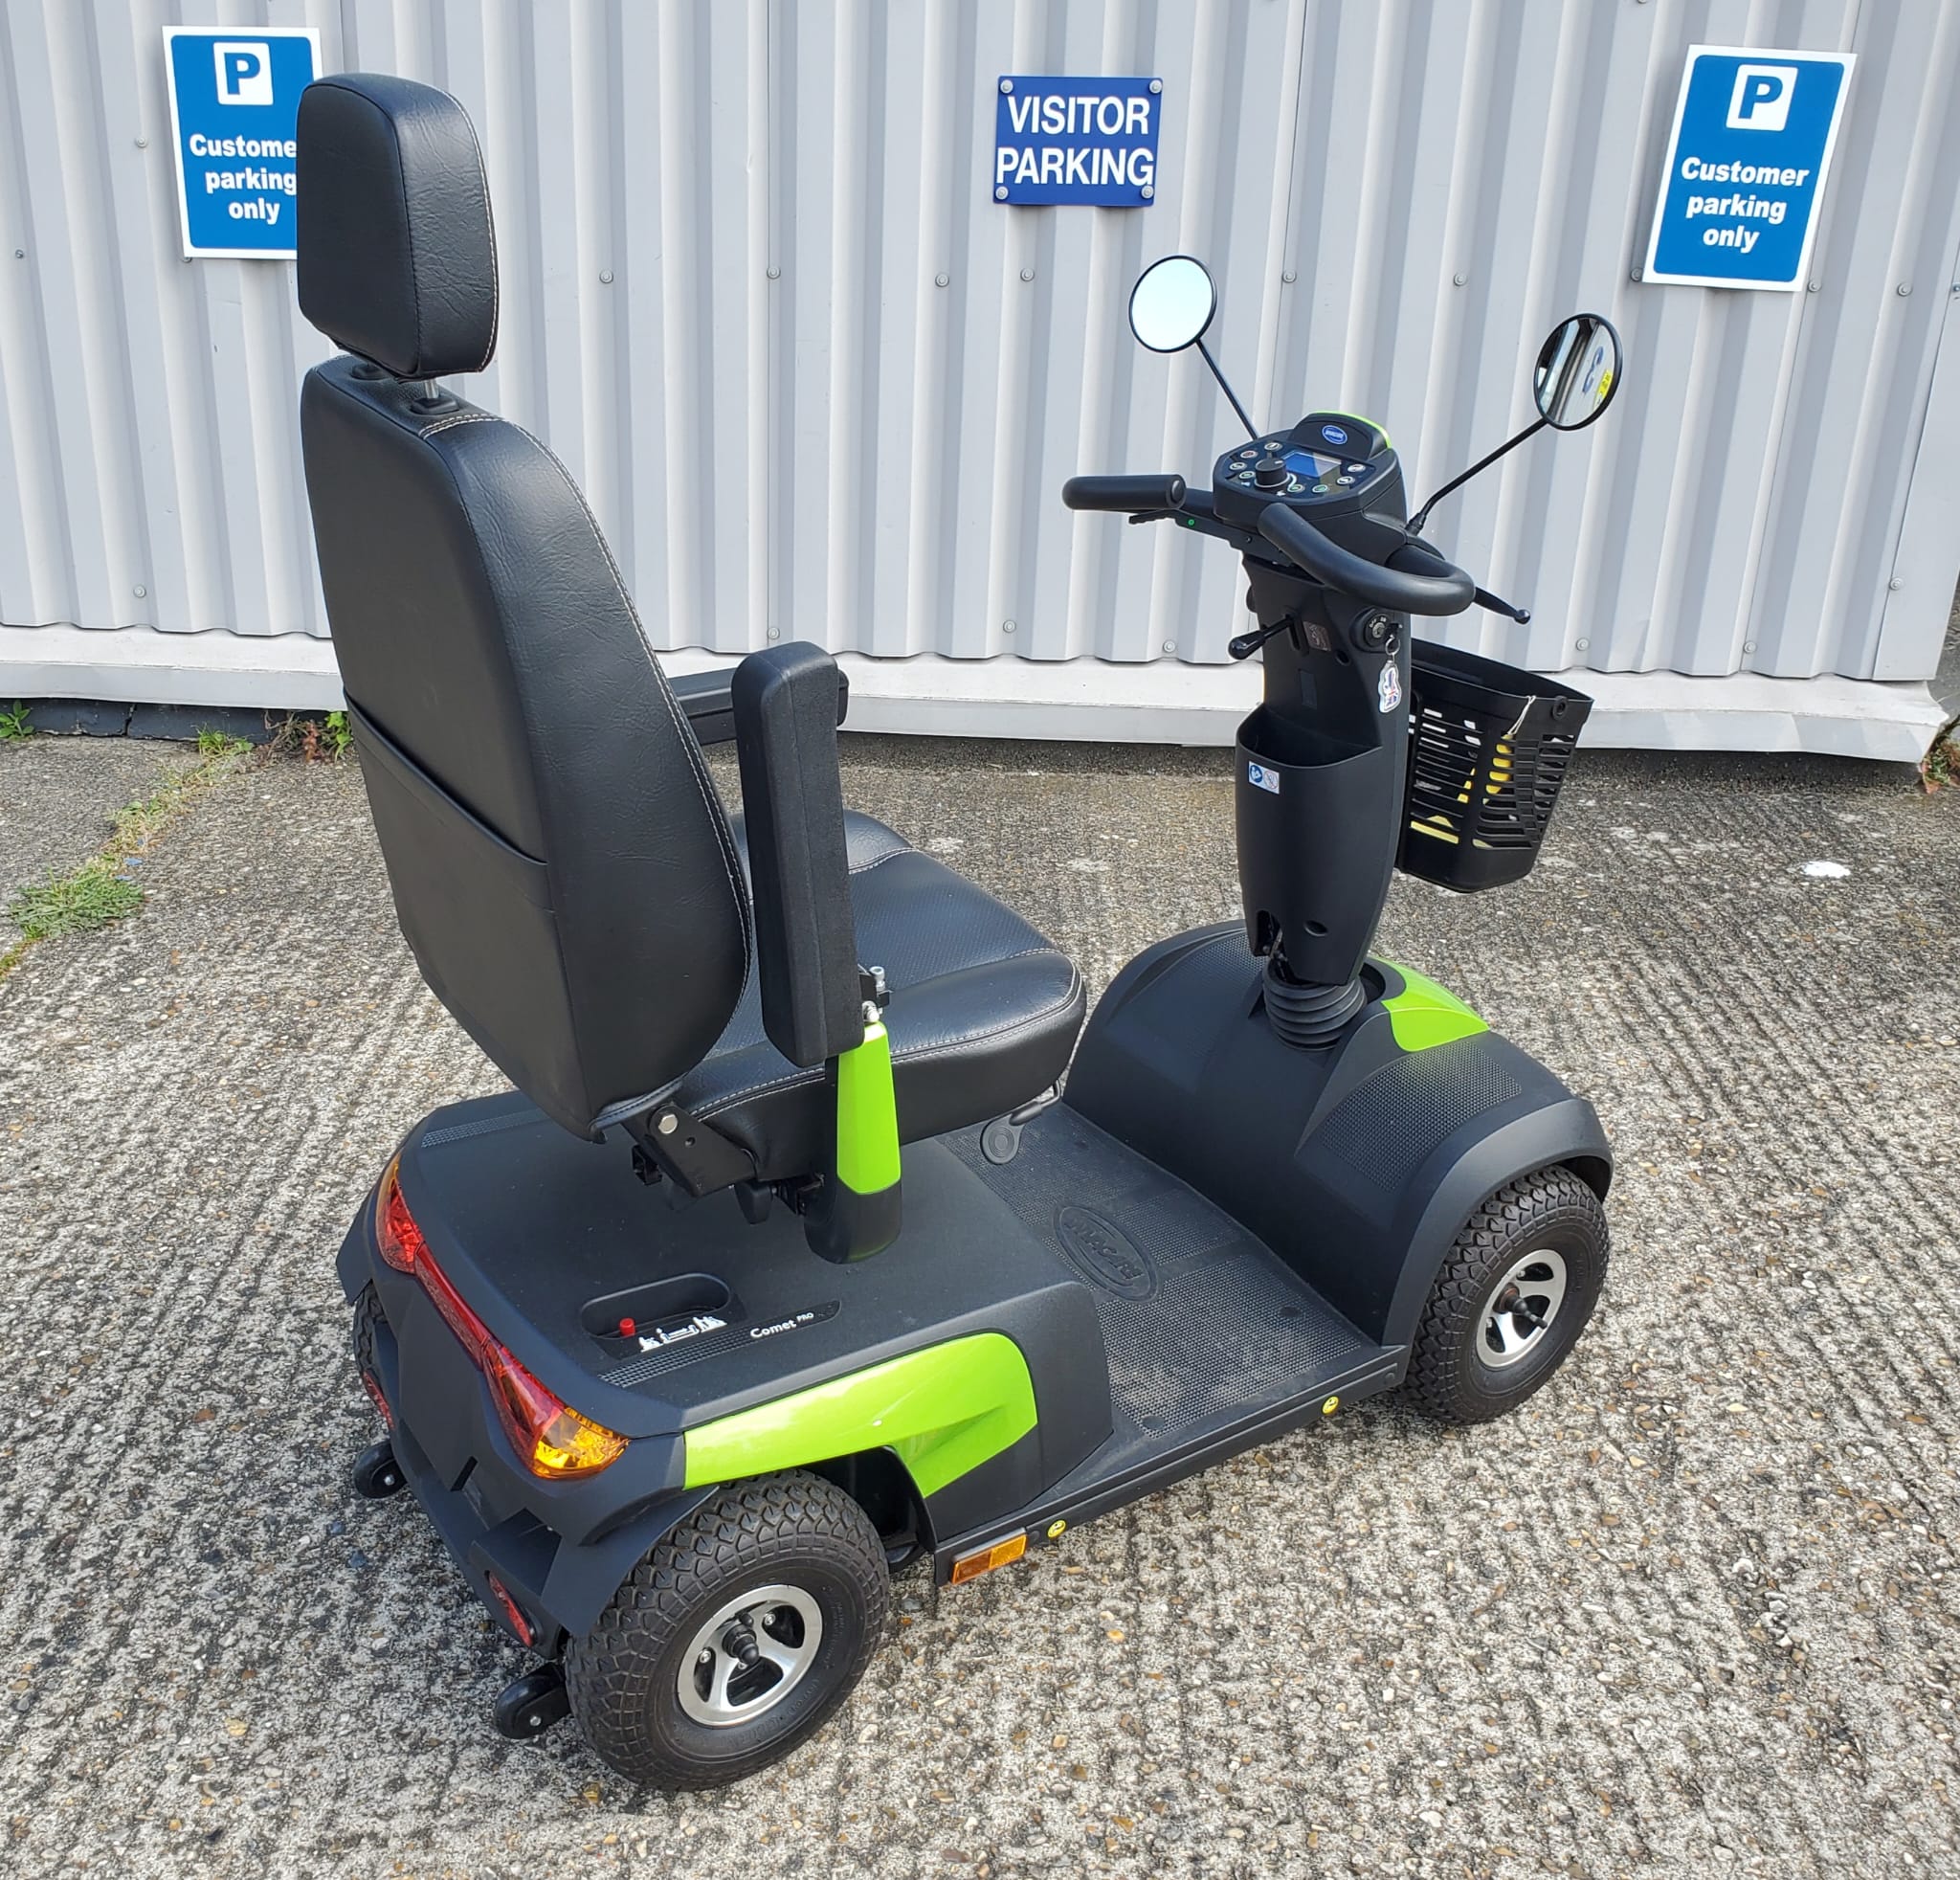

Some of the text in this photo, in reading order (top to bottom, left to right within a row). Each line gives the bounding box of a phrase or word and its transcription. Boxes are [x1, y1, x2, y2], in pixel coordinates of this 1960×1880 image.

[224, 52, 260, 95] P
[1737, 75, 1783, 120] P
[1007, 96, 1150, 135] VISITOR
[189, 134, 297, 157] Custome
[996, 147, 1154, 186] PARKING
[1682, 157, 1810, 186] Customer
[206, 168, 297, 195] parking
[228, 197, 279, 224] only
[1685, 194, 1787, 224] parking
[1703, 225, 1760, 253] only
[750, 1312, 814, 1338] Comet PRO
